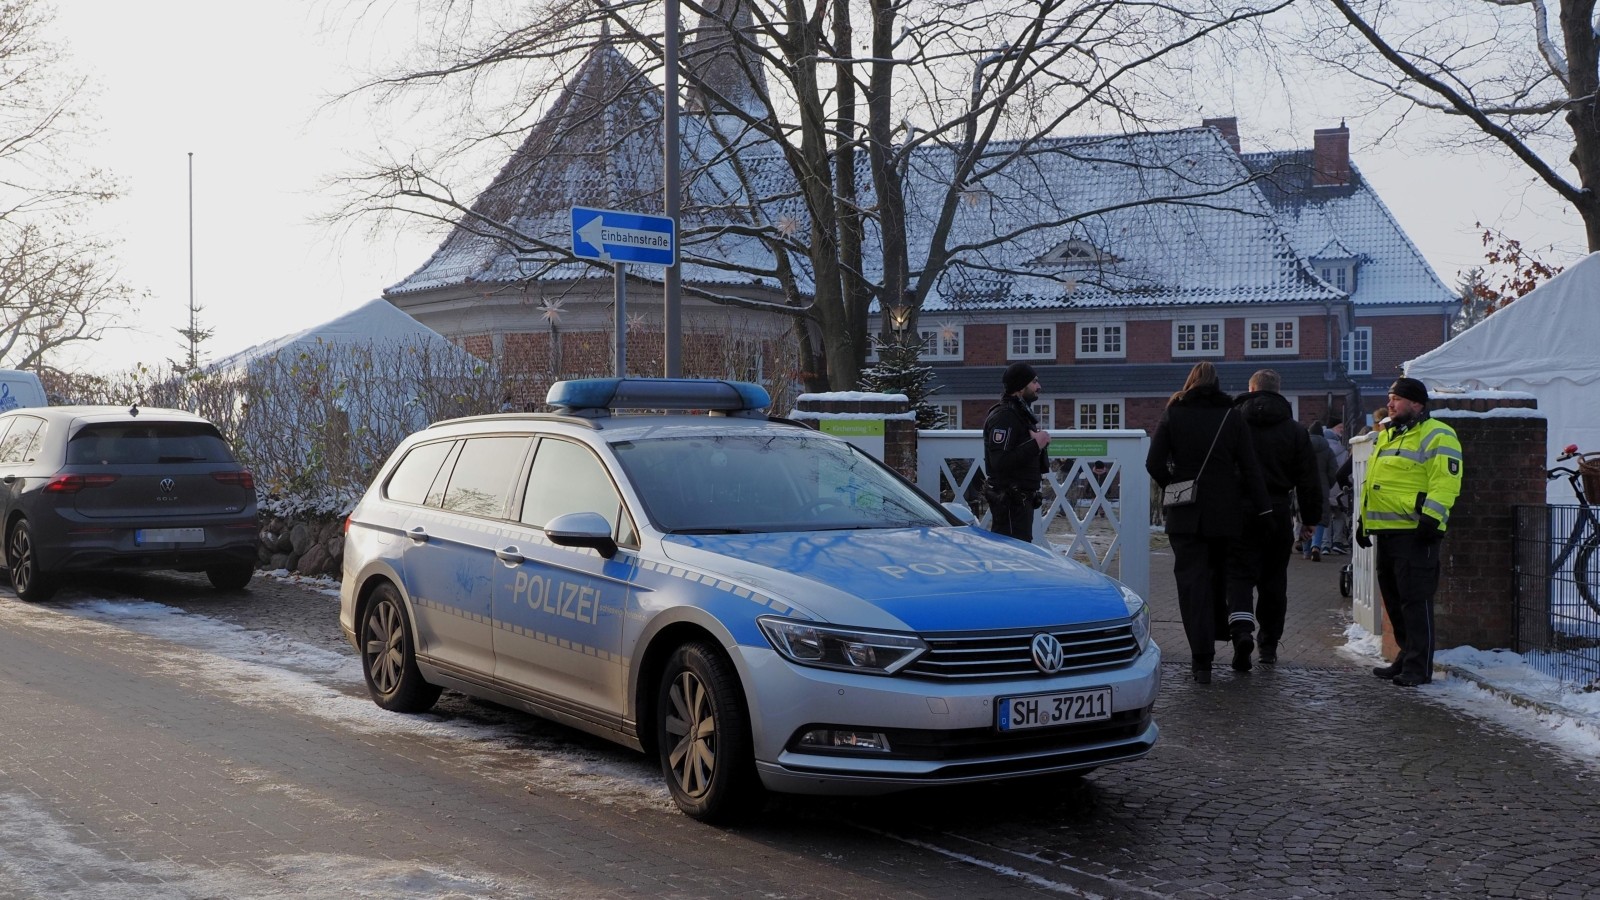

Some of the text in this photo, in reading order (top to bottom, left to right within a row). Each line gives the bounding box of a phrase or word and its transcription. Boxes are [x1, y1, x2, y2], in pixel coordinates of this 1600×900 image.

[601, 229, 668, 247] Einbahnstraße
[876, 559, 1045, 579] POLIZEI
[513, 571, 601, 625] POLIZEI
[1013, 700, 1039, 726] SH
[1051, 693, 1107, 722] 37211
